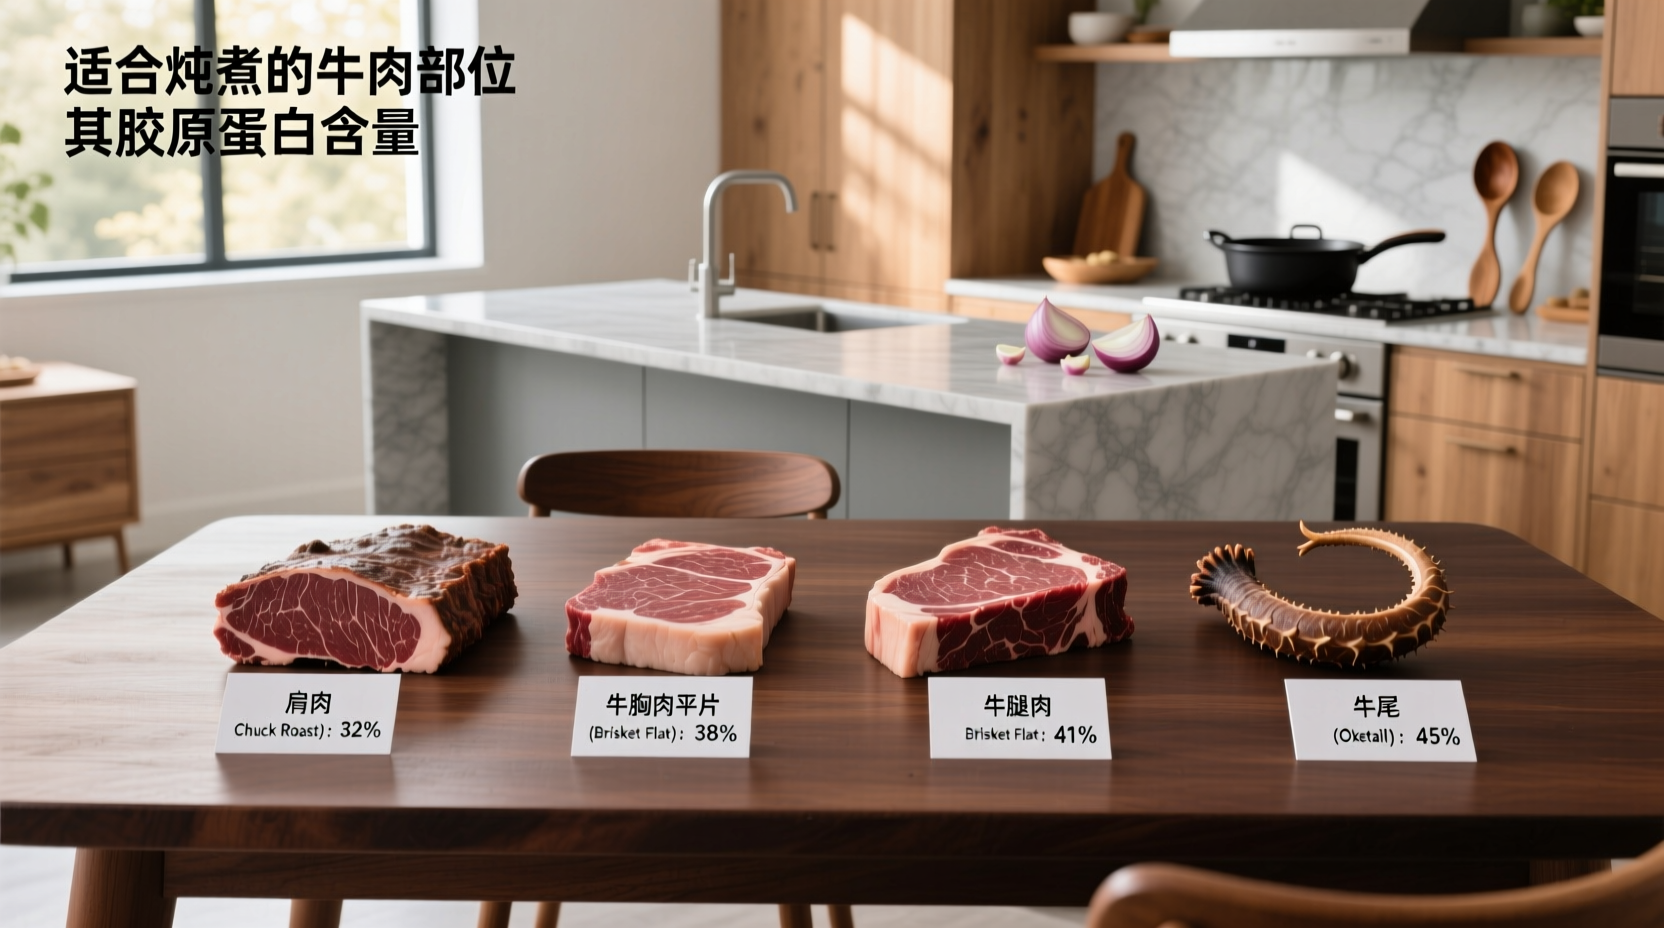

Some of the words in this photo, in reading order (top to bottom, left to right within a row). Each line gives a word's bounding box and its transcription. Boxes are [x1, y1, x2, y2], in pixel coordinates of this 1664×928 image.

[284, 689, 332, 714] 肩肉
[983, 693, 1051, 718] 牛腿肉
[1353, 694, 1401, 718] 牛尾
[234, 722, 277, 737] Chuck
[339, 720, 382, 738] 32%
[694, 723, 738, 742] 38%
[1053, 724, 1098, 744] 41%
[1415, 726, 1461, 745] 45%
